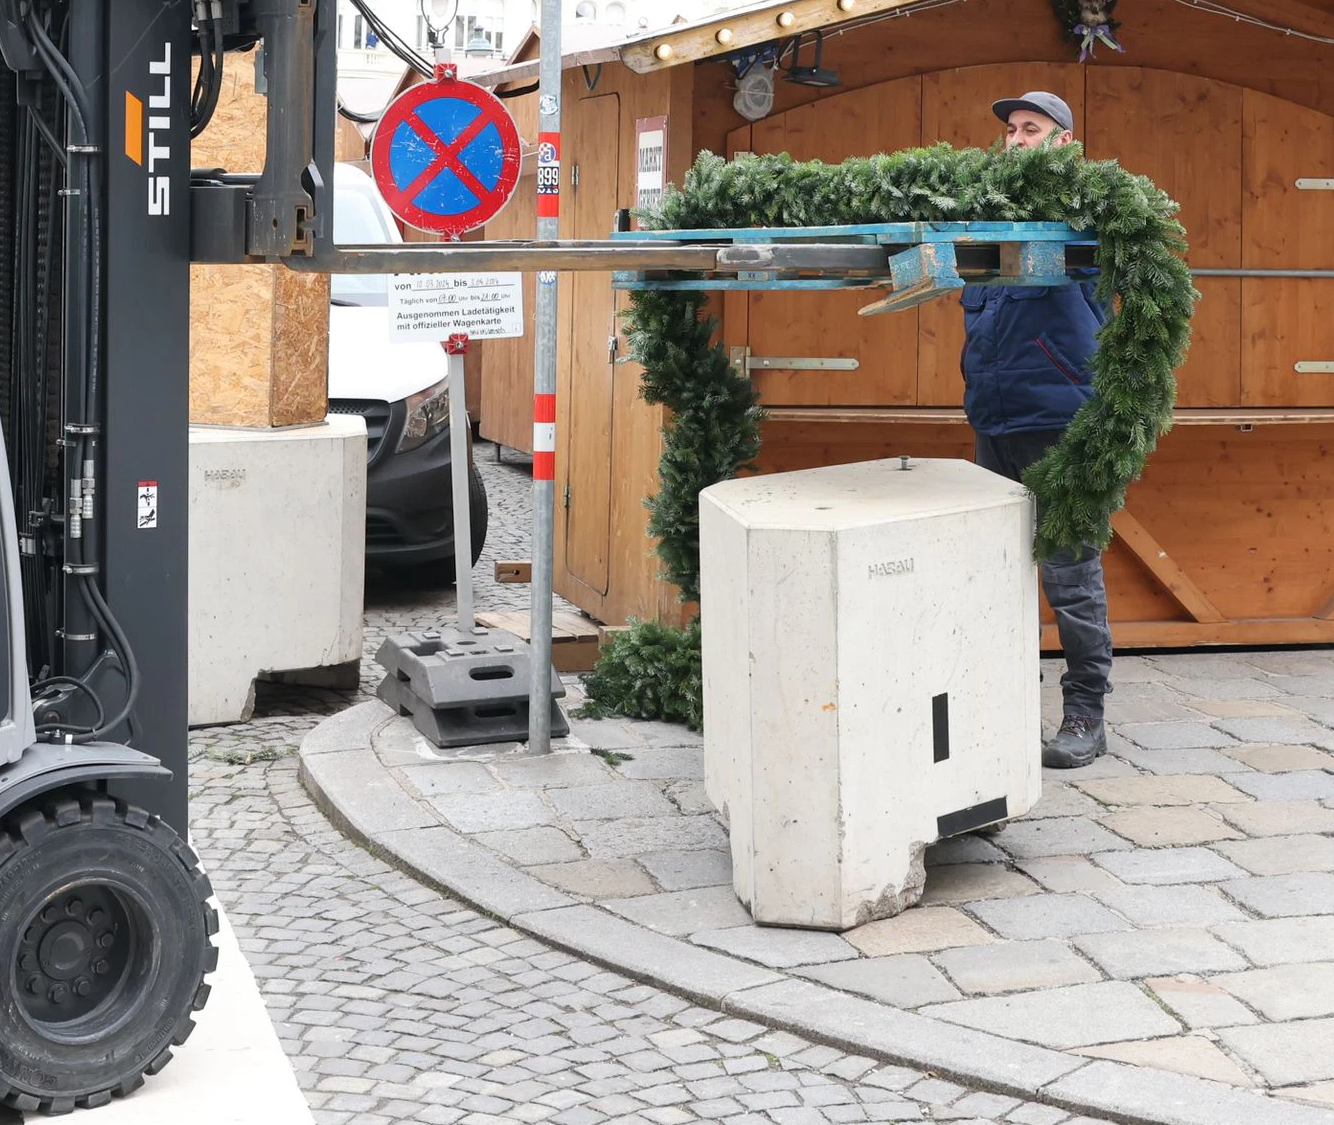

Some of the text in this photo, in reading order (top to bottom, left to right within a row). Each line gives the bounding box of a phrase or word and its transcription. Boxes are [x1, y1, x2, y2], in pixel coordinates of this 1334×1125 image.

[148, 42, 171, 216] STILL
[639, 146, 662, 172] MARKT
[538, 167, 559, 186] 899
[394, 283, 412, 291] von
[453, 279, 468, 287] bis
[400, 297, 424, 305] Täglich
[396, 305, 515, 321] Ausgenommen Ladetätigkeit
[397, 318, 502, 330] mit offizieller Wagenkarte
